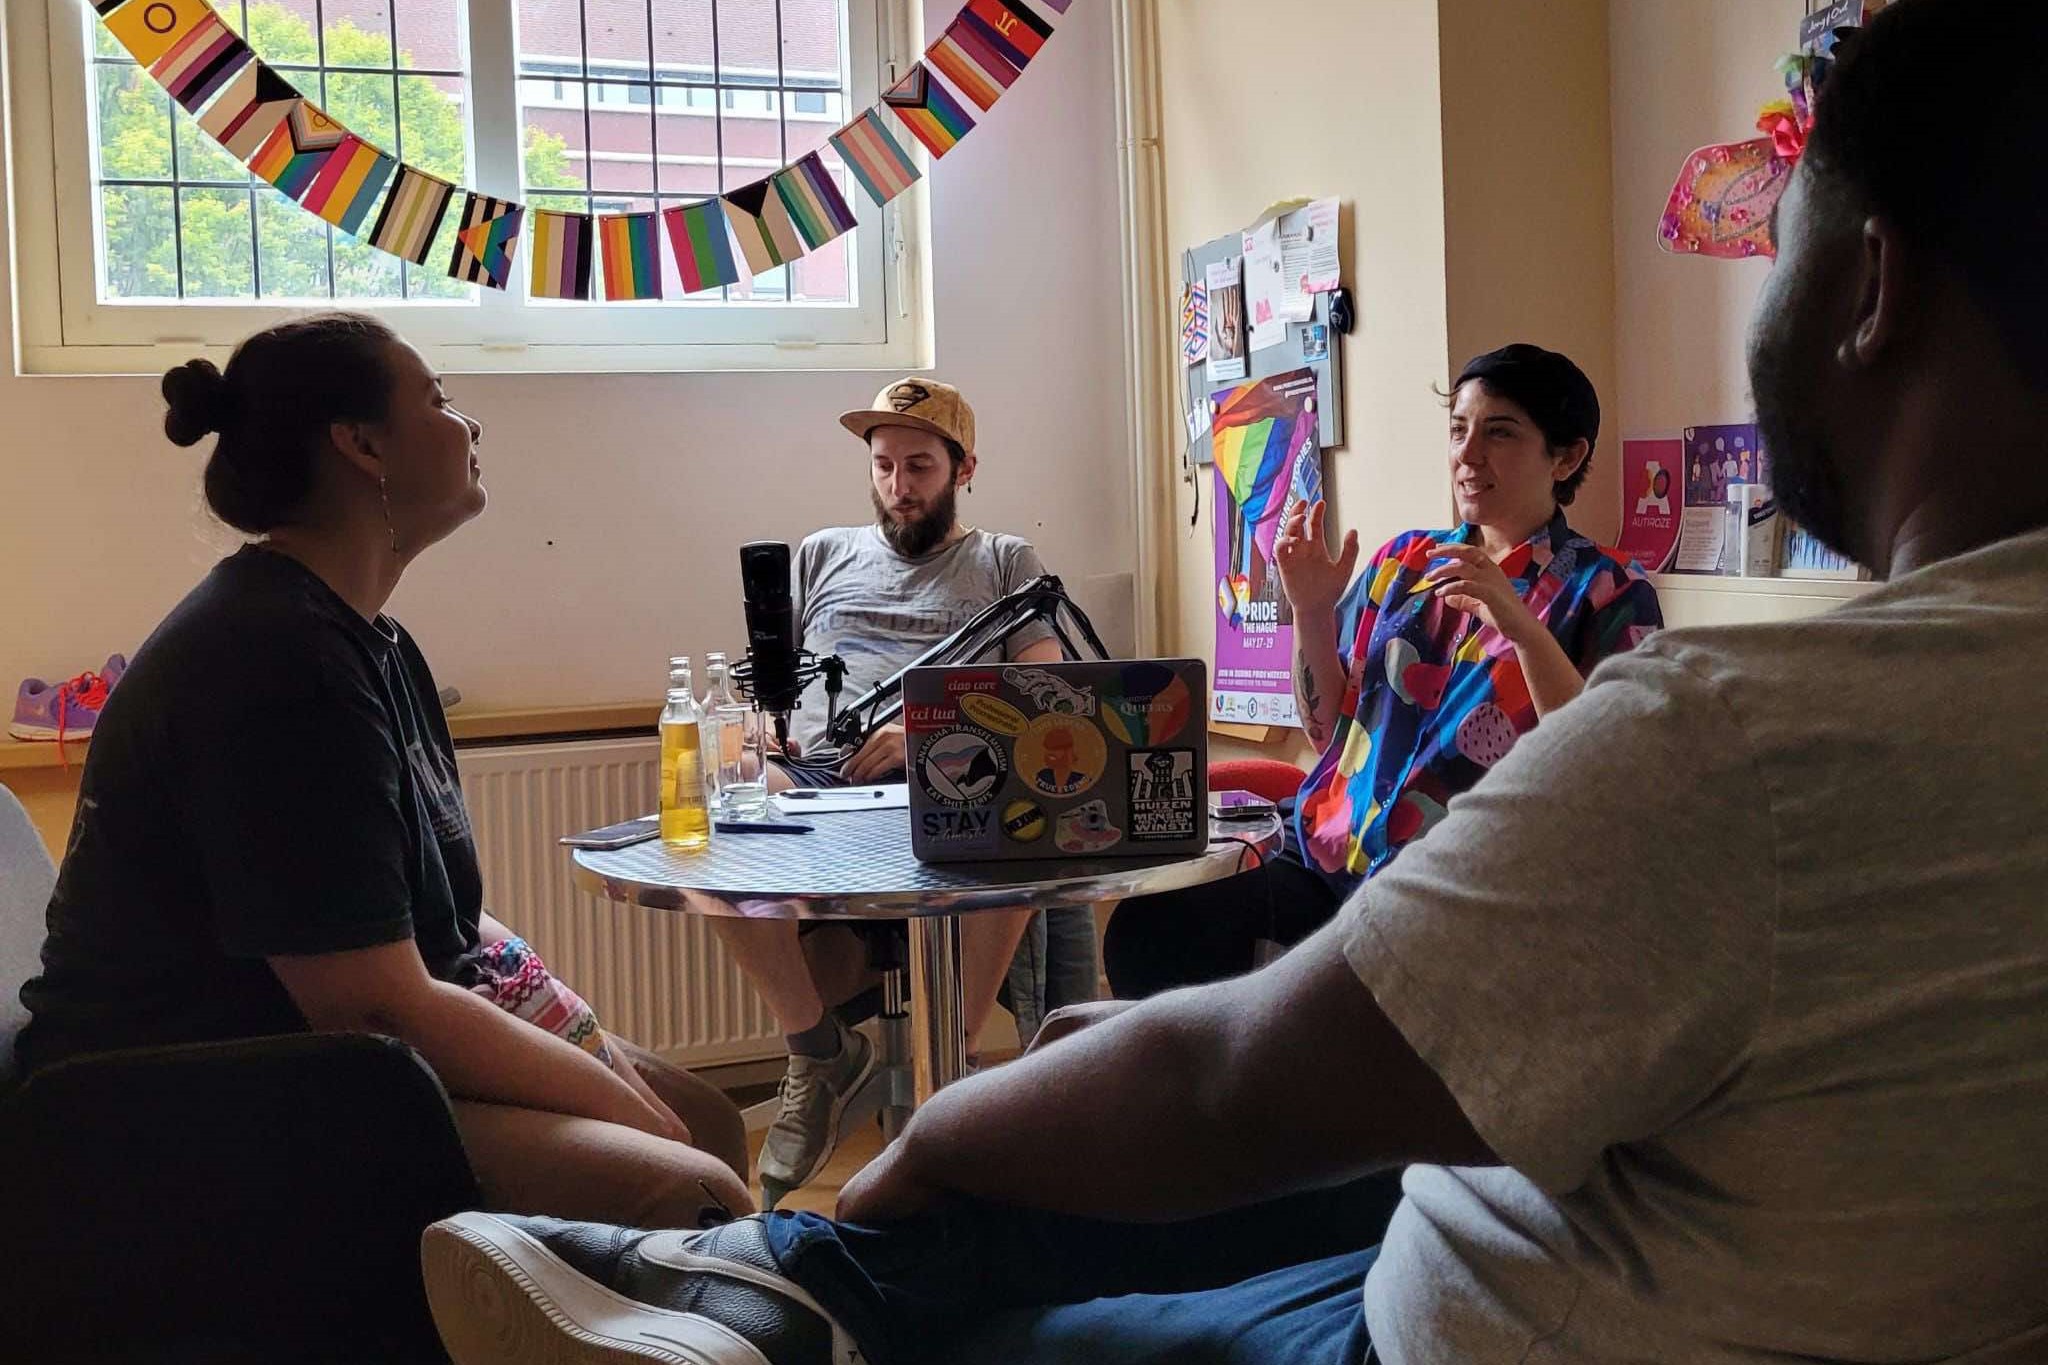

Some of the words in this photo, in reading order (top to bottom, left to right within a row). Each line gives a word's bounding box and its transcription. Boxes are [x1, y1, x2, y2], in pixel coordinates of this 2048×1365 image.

[1291, 436, 1313, 492] STORIES
[1243, 601, 1278, 622] PRIDE
[1243, 622, 1255, 634] THE
[1255, 622, 1278, 634] HAGUE
[1243, 637, 1256, 649] MAY
[942, 798, 963, 810] SHIT
[1134, 801, 1191, 811] HUIZEN
[923, 811, 992, 836] STAY
[1134, 822, 1193, 832] WINST!
